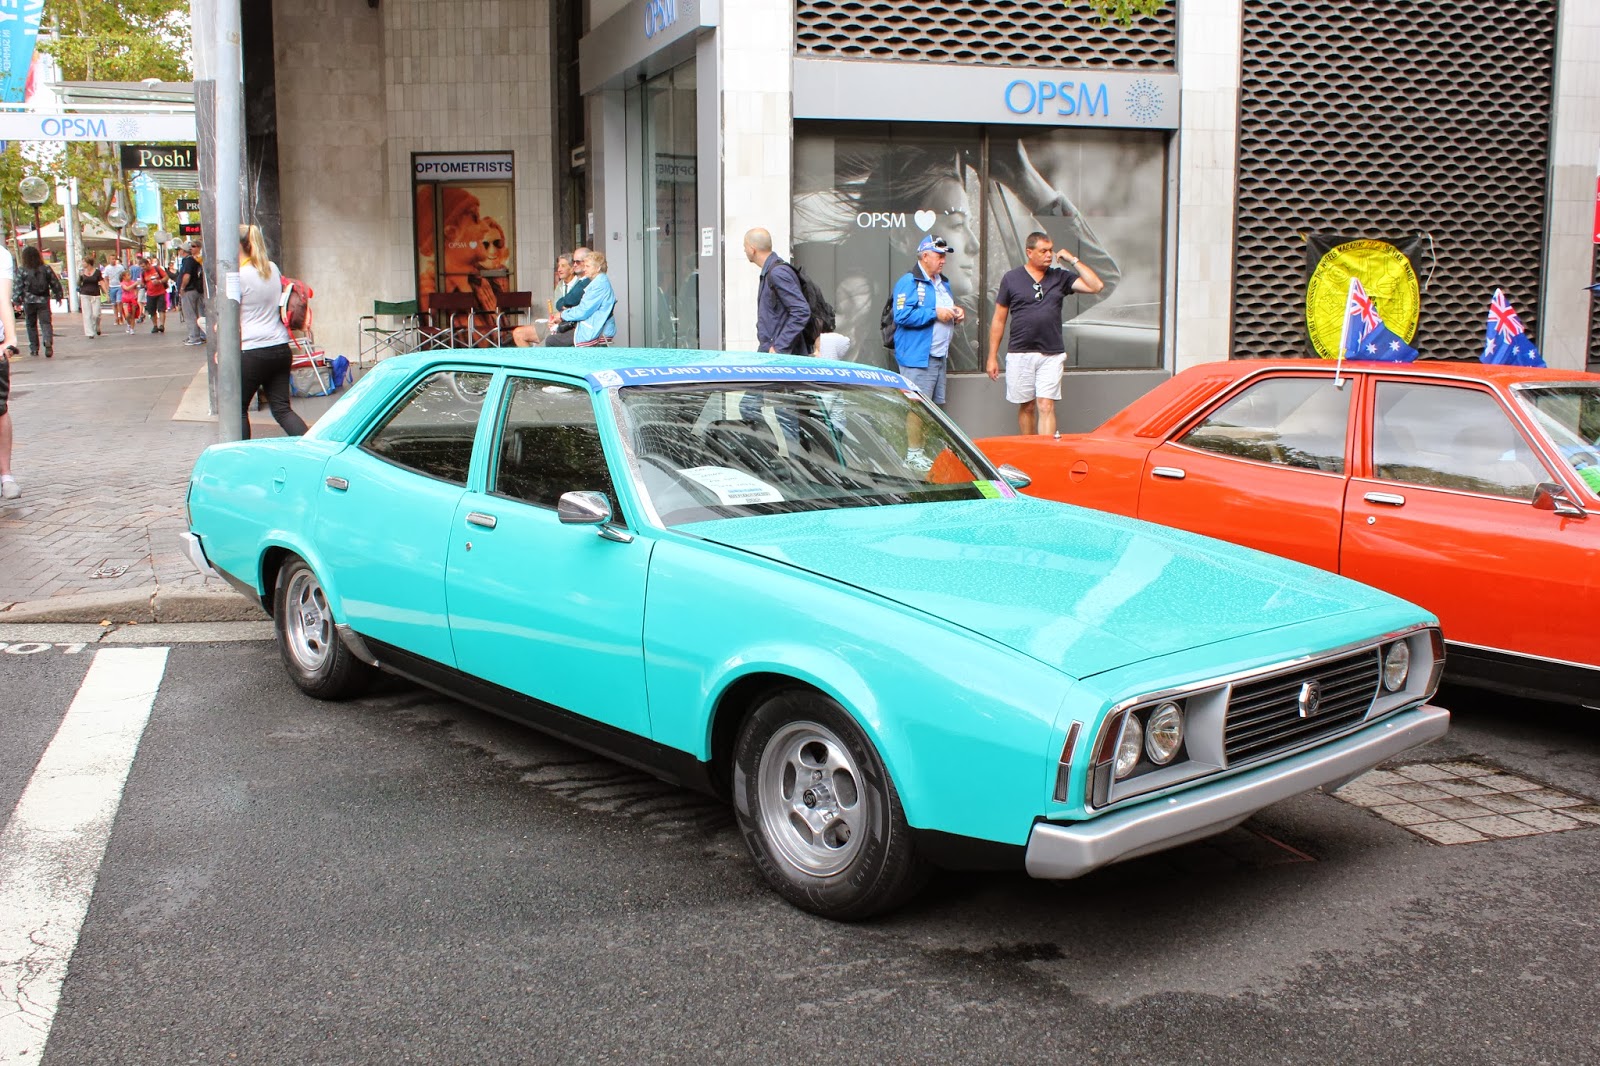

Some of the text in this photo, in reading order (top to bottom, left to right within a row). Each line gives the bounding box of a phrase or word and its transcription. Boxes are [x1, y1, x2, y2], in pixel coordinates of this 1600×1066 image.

[645, 0, 677, 39] OPSM
[1004, 79, 1109, 117] OPSM
[41, 118, 107, 138] OPSM
[139, 149, 191, 167] Posh!
[415, 161, 513, 173] OPTOMETRISTS
[857, 212, 906, 228] OPSM
[623, 366, 899, 384] LEYLAND P76 OWNERS CLUB OF NSW Inc
